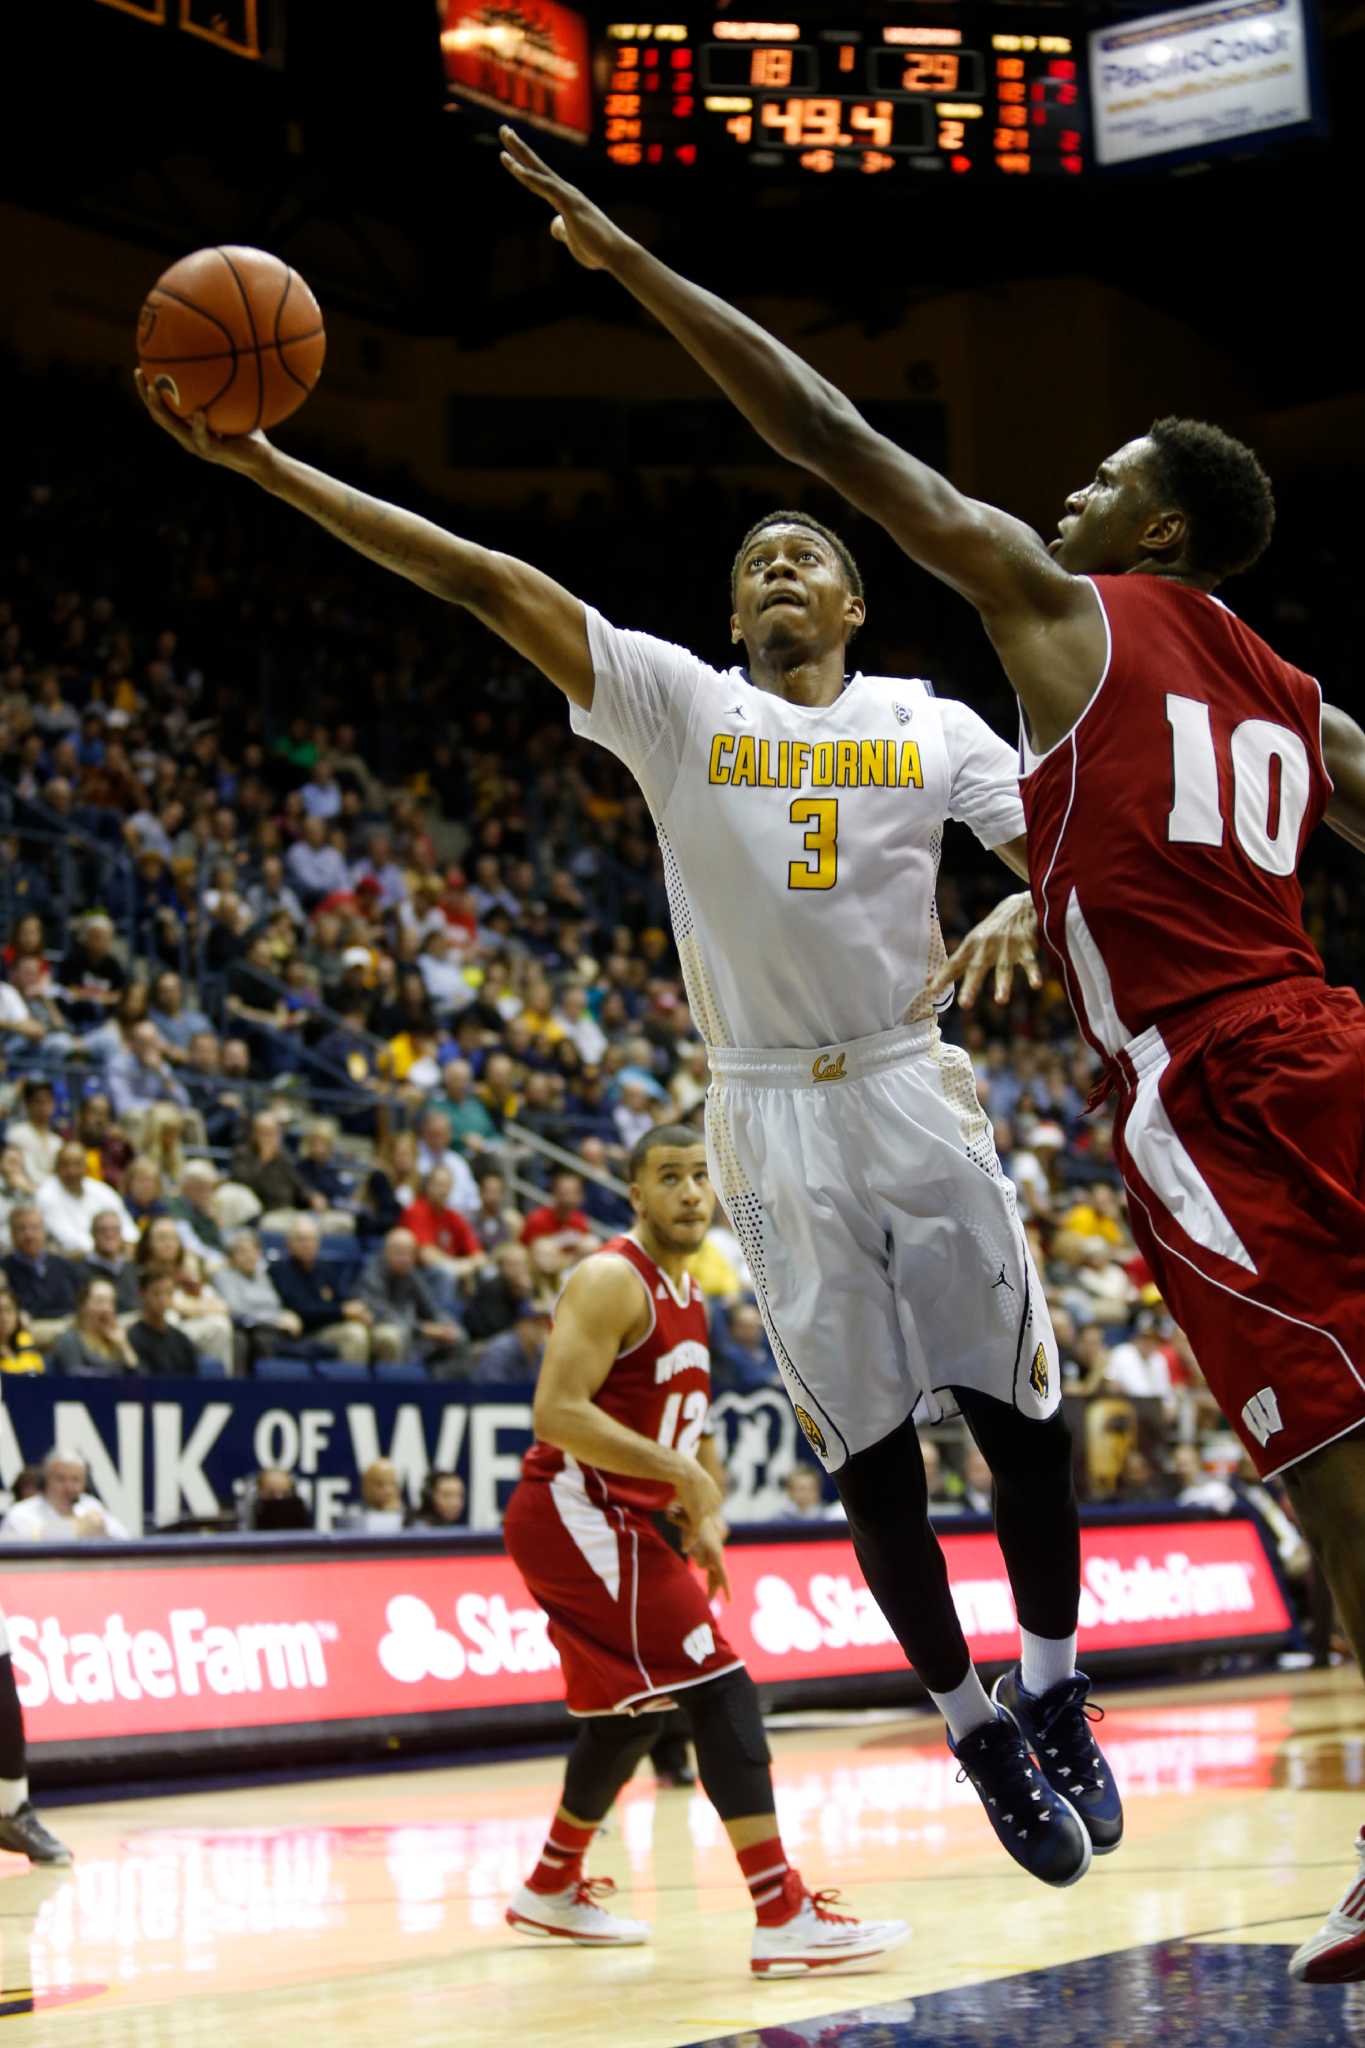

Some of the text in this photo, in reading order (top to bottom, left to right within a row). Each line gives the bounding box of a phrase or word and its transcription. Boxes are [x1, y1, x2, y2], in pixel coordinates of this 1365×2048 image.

[751, 48, 793, 88] 18
[902, 52, 959, 91] 29
[761, 98, 893, 146] 49.4
[708, 733, 925, 789] CALIFORNIA
[1166, 693, 1311, 877] 10
[787, 797, 839, 890] 3
[812, 1052, 847, 1083] Cal
[658, 1391, 708, 1461] 12
[254, 1409, 336, 1473] OF
[346, 1402, 533, 1531] WE
